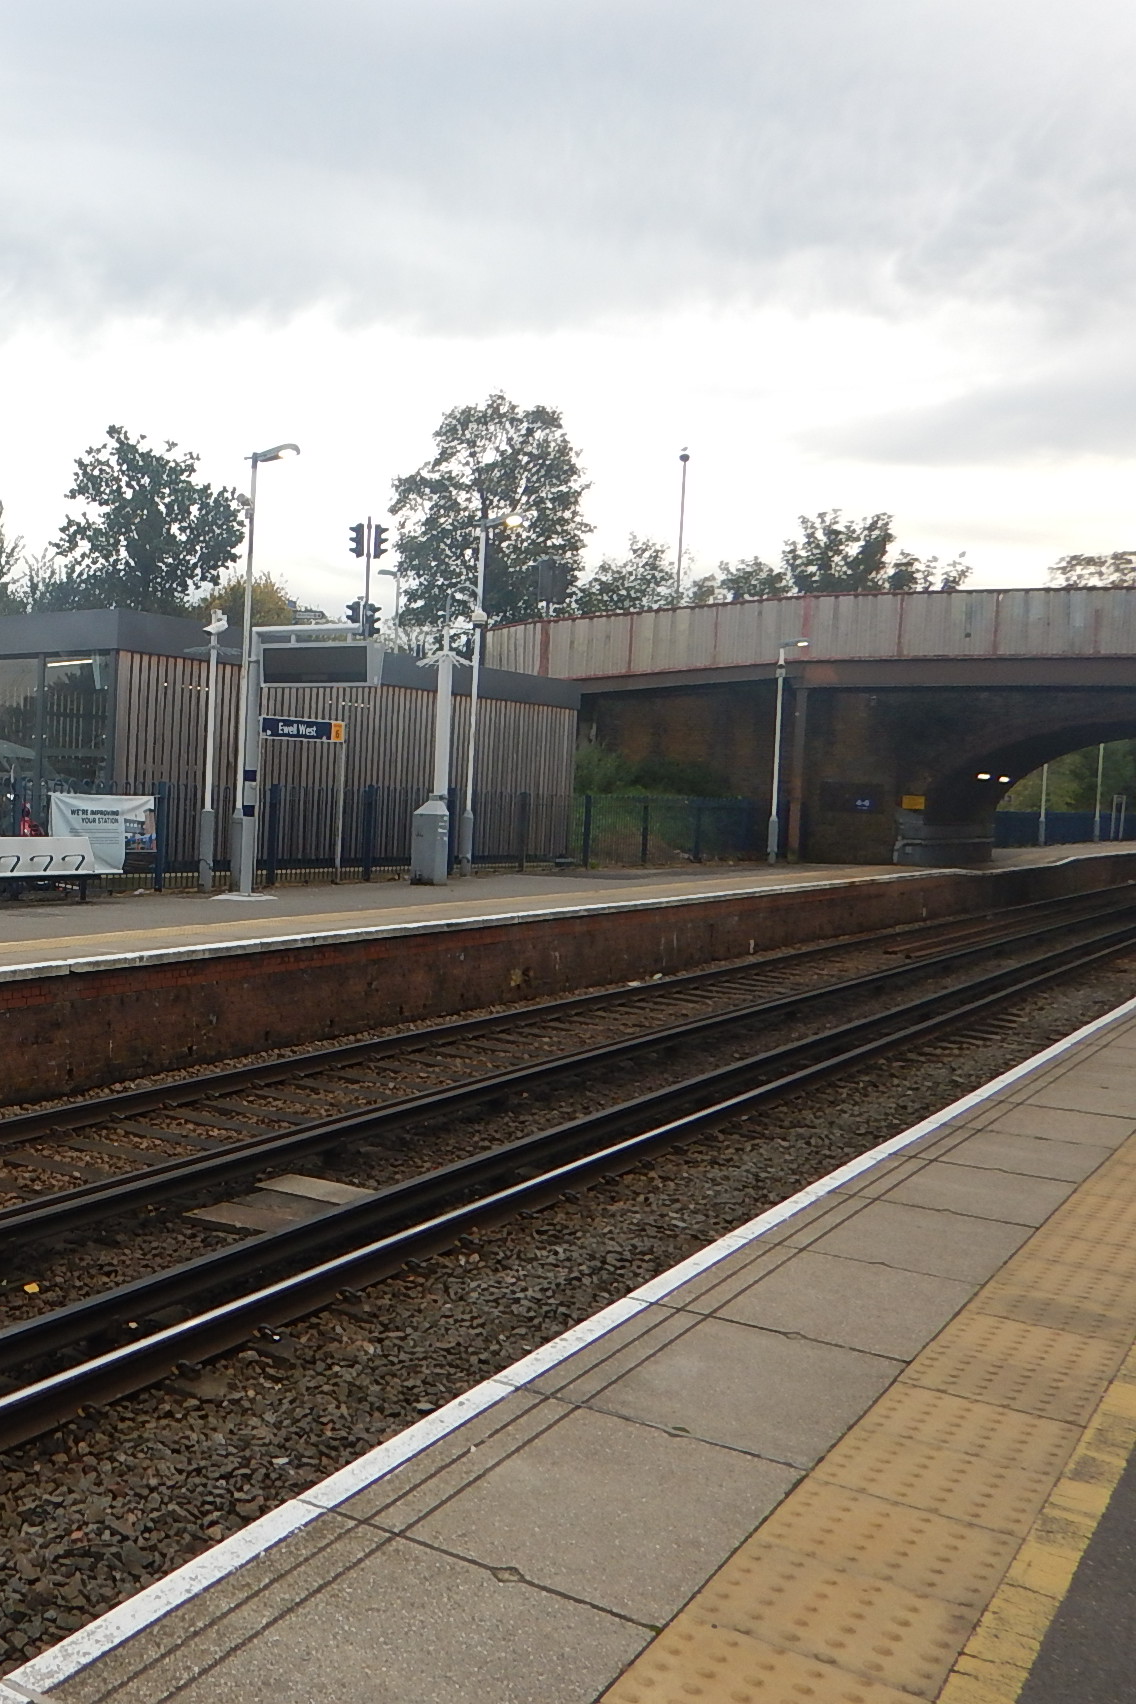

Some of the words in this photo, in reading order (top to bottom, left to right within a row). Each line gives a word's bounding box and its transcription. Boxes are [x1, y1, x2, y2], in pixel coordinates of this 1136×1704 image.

[278, 722, 298, 735] Ewell
[298, 724, 317, 736] West
[335, 730, 340, 739] 6
[70, 808, 89, 816] WE'RE
[89, 809, 120, 817] IMPROVING
